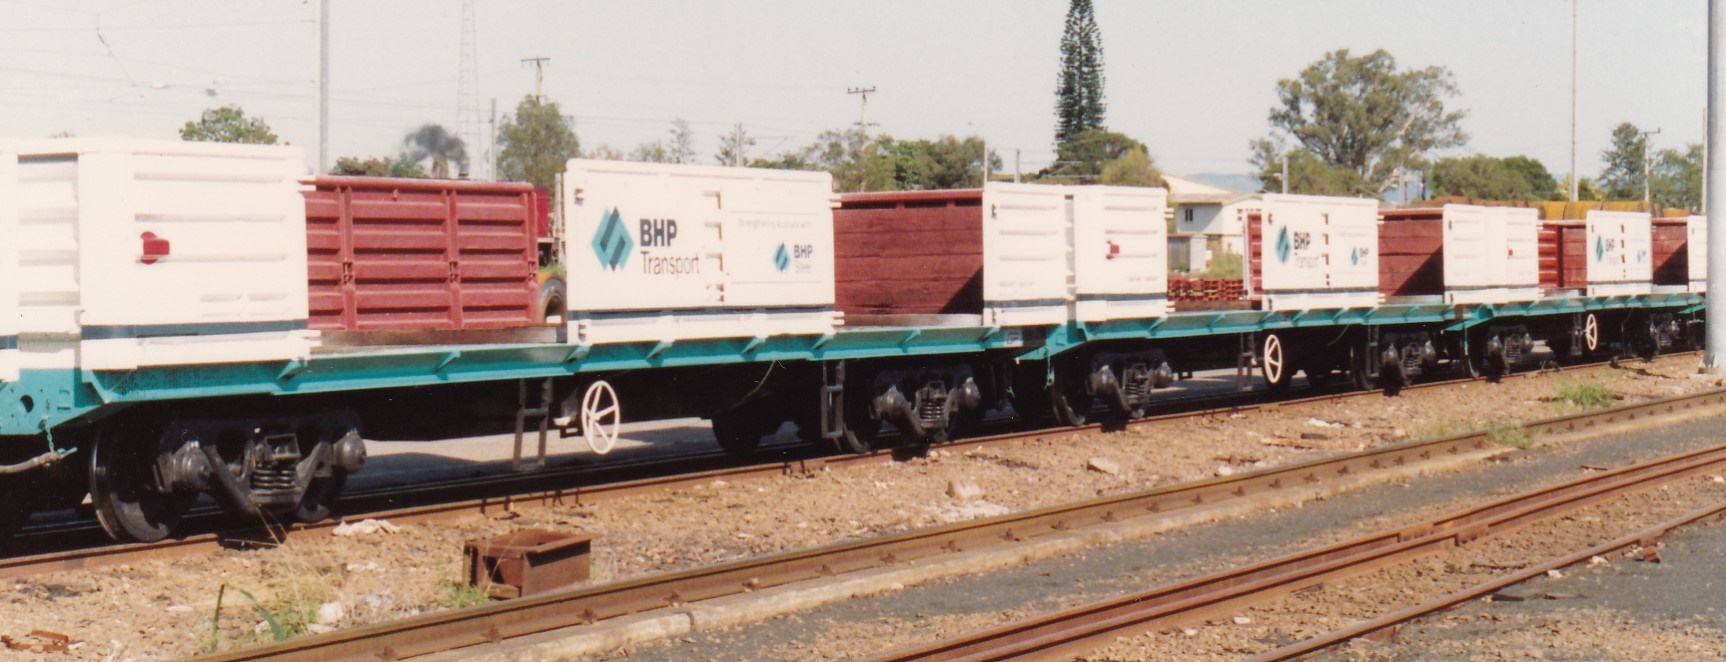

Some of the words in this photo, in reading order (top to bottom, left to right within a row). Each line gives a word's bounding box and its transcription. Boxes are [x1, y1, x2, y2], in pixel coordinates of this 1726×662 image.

[639, 218, 678, 247] BHP
[1293, 231, 1311, 250] BHP
[793, 244, 813, 259] BHP
[640, 250, 700, 279] Transport
